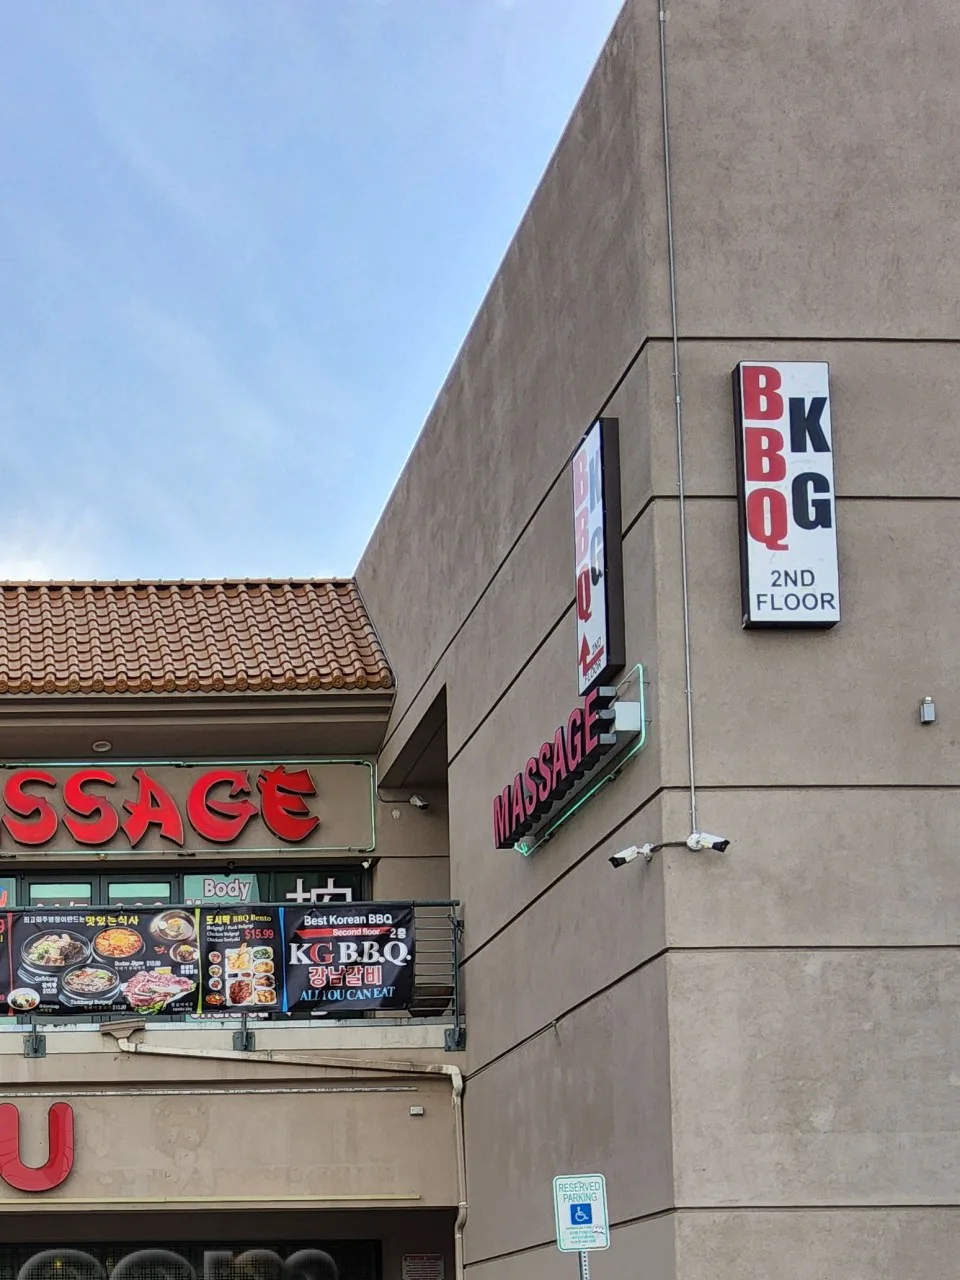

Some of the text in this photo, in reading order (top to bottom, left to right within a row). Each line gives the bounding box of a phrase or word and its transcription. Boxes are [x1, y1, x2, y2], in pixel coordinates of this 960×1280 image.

[771, 570, 815, 588] 2ND
[757, 592, 836, 611] FLOOR
[493, 687, 598, 849] MASSAGE
[203, 878, 251, 900] Body
[206, 914, 230, 925] 도시락
[233, 914, 272, 923] BBQ Bento
[303, 914, 393, 926] Best Korean BBQ
[244, 929, 274, 940] $15.99
[332, 928, 380, 936] Second floor
[308, 966, 383, 988] 강남갈비
[300, 990, 321, 1001] ALL
[346, 988, 372, 1000] CAN
[373, 986, 396, 999] EAT
[558, 1181, 601, 1193] RESERVED
[563, 1192, 597, 1203] PARKING
